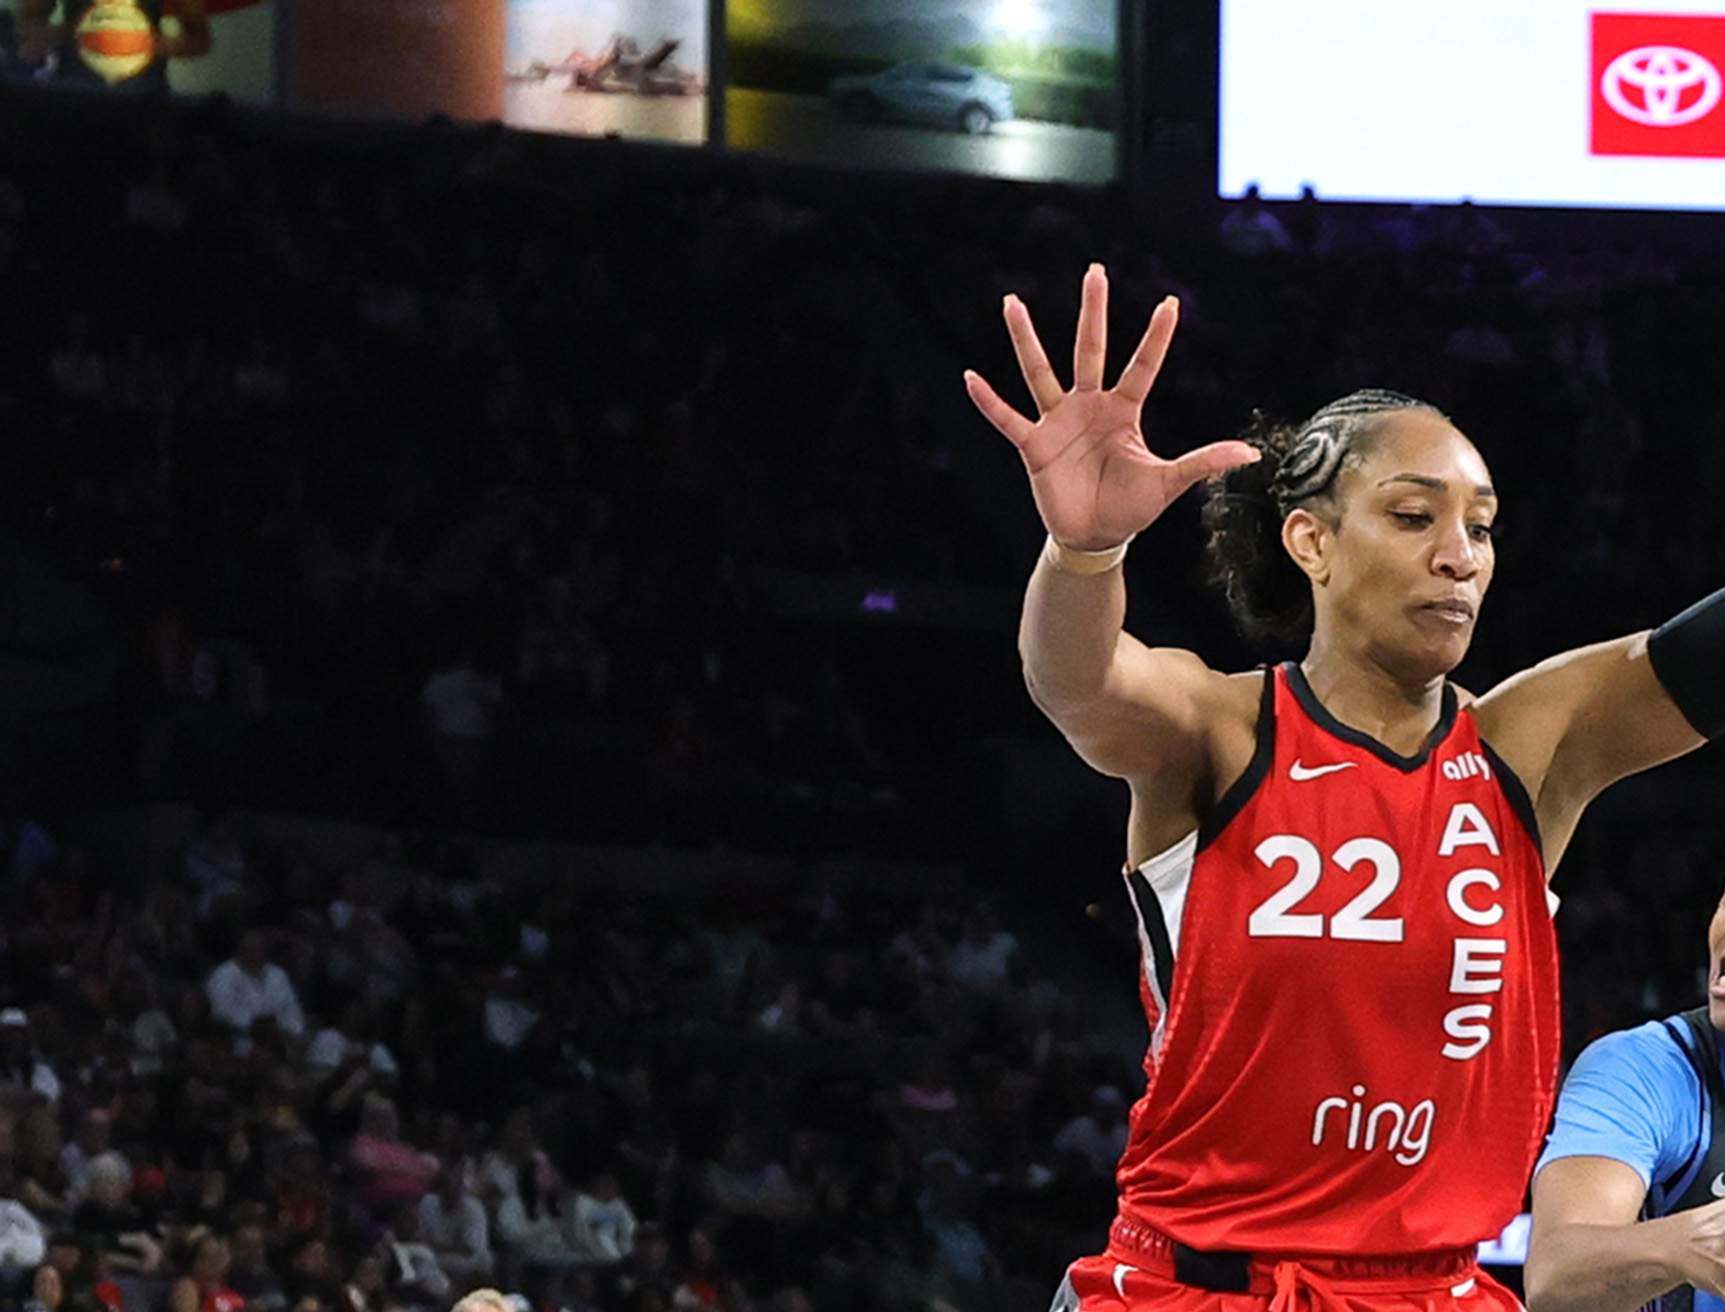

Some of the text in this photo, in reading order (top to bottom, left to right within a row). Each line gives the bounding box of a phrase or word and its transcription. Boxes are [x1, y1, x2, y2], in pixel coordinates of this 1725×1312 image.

[1442, 750, 1491, 781] ally
[1248, 834, 1406, 942] 22
[1438, 802, 1508, 1062] ACES
[1311, 1084, 1435, 1166] ring
